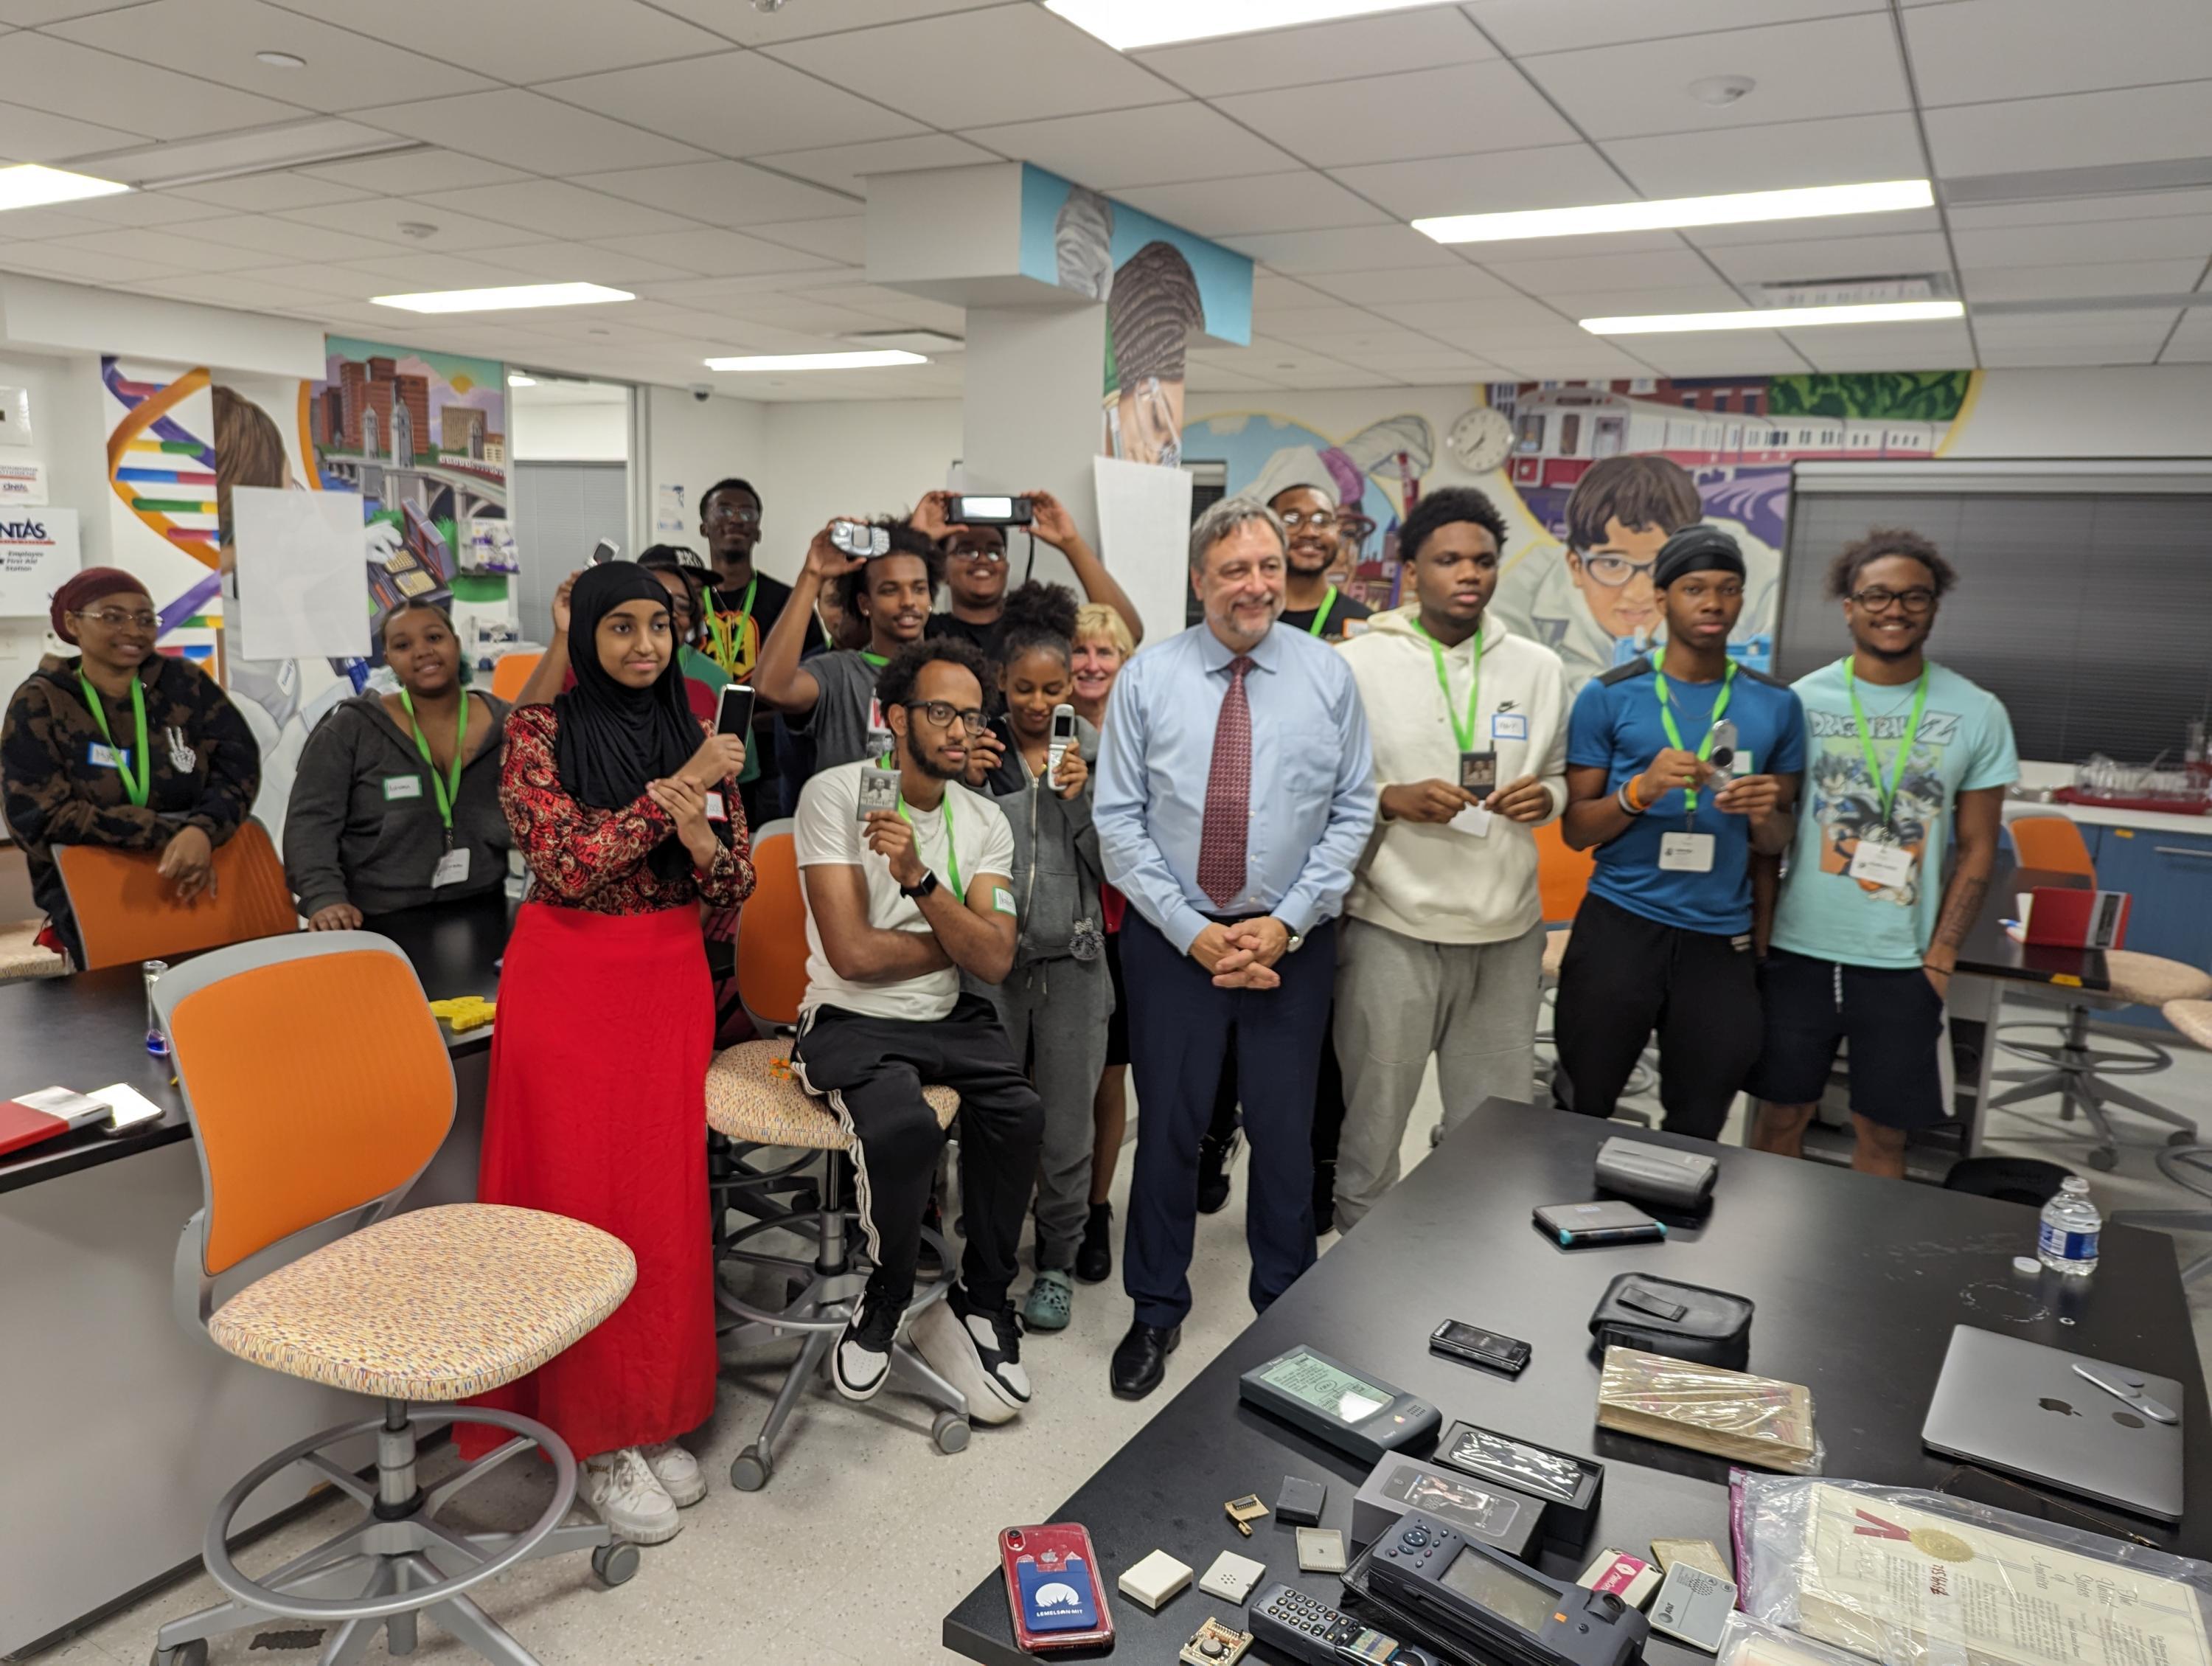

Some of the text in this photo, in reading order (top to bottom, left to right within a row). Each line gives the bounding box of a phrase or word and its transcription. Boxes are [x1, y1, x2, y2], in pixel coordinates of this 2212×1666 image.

[8, 550, 44, 558] Employee
[1914, 710, 1963, 746] Z
[2031, 1555, 2052, 1590] America
[2050, 1574, 2075, 1586] of
[2073, 1572, 2094, 1598] States
[2096, 1578, 2119, 1608] United
[2117, 1589, 2139, 1606] The
